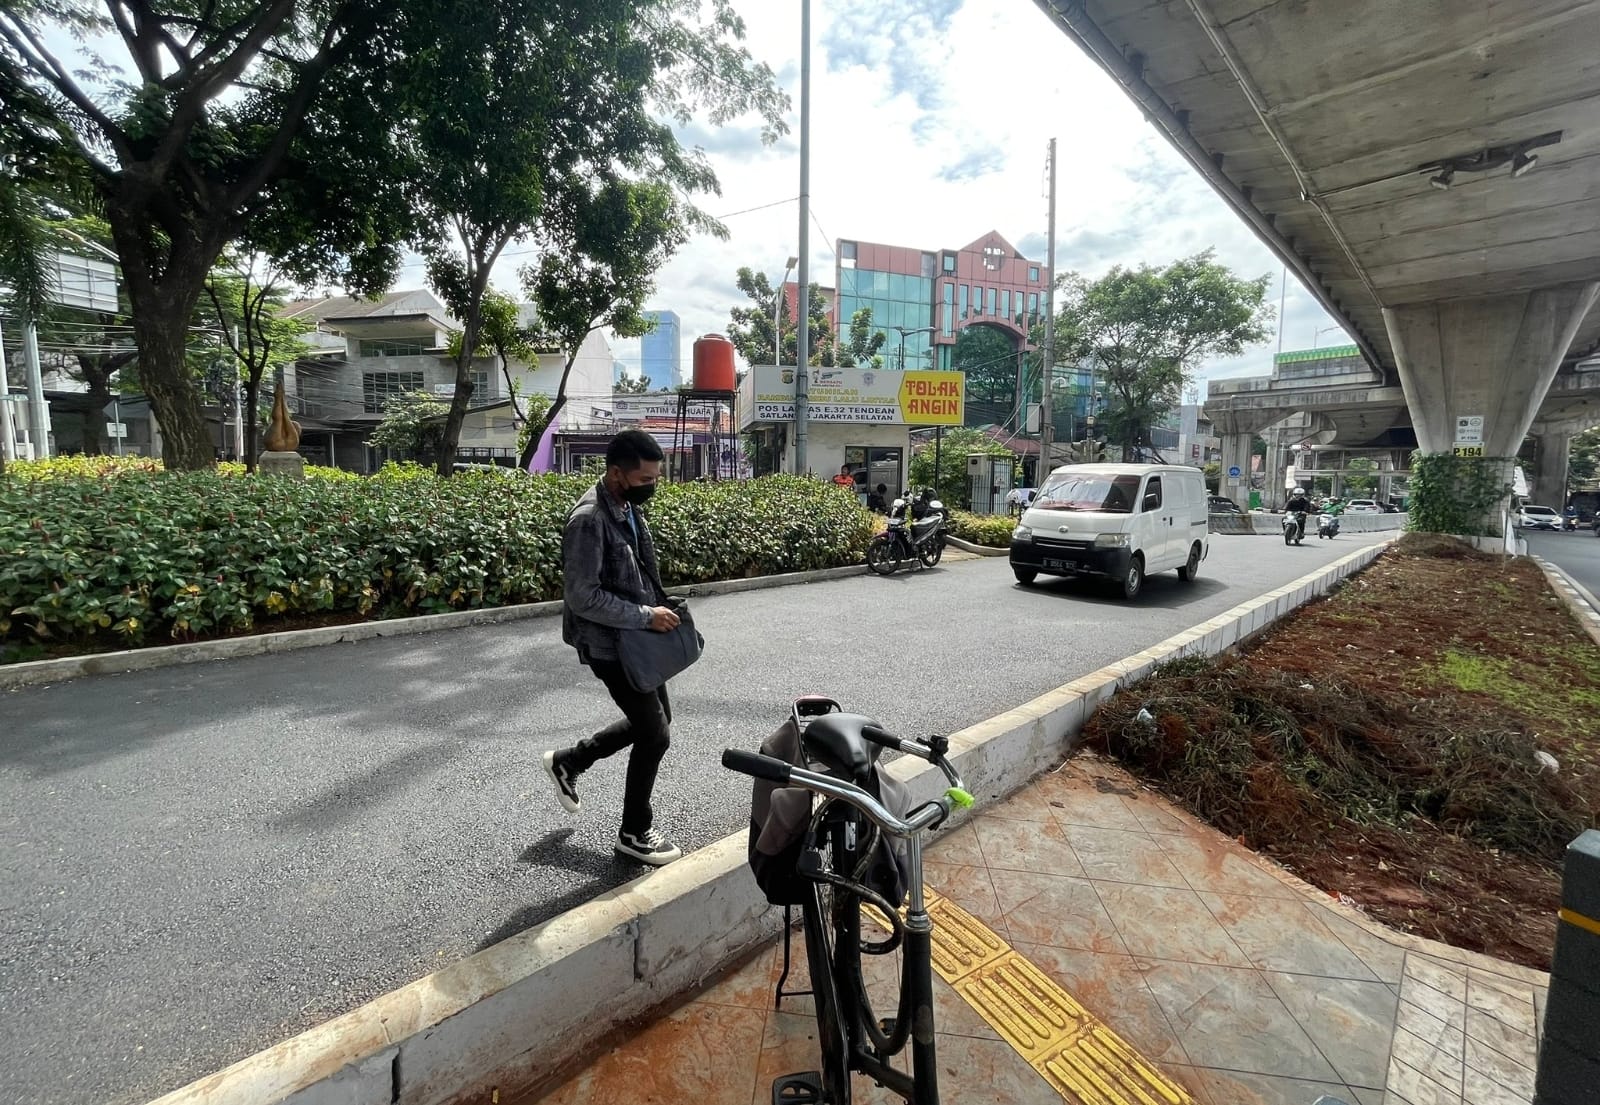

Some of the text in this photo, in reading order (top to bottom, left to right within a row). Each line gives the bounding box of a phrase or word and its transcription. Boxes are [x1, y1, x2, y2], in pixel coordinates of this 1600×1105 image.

[905, 381, 960, 397] TOLAK
[645, 407, 669, 415] YATIM
[684, 408, 712, 416] HUAFA
[782, 405, 821, 413] LAAS
[907, 399, 958, 415] ANGIN
[1453, 447, 1482, 457] P.194
